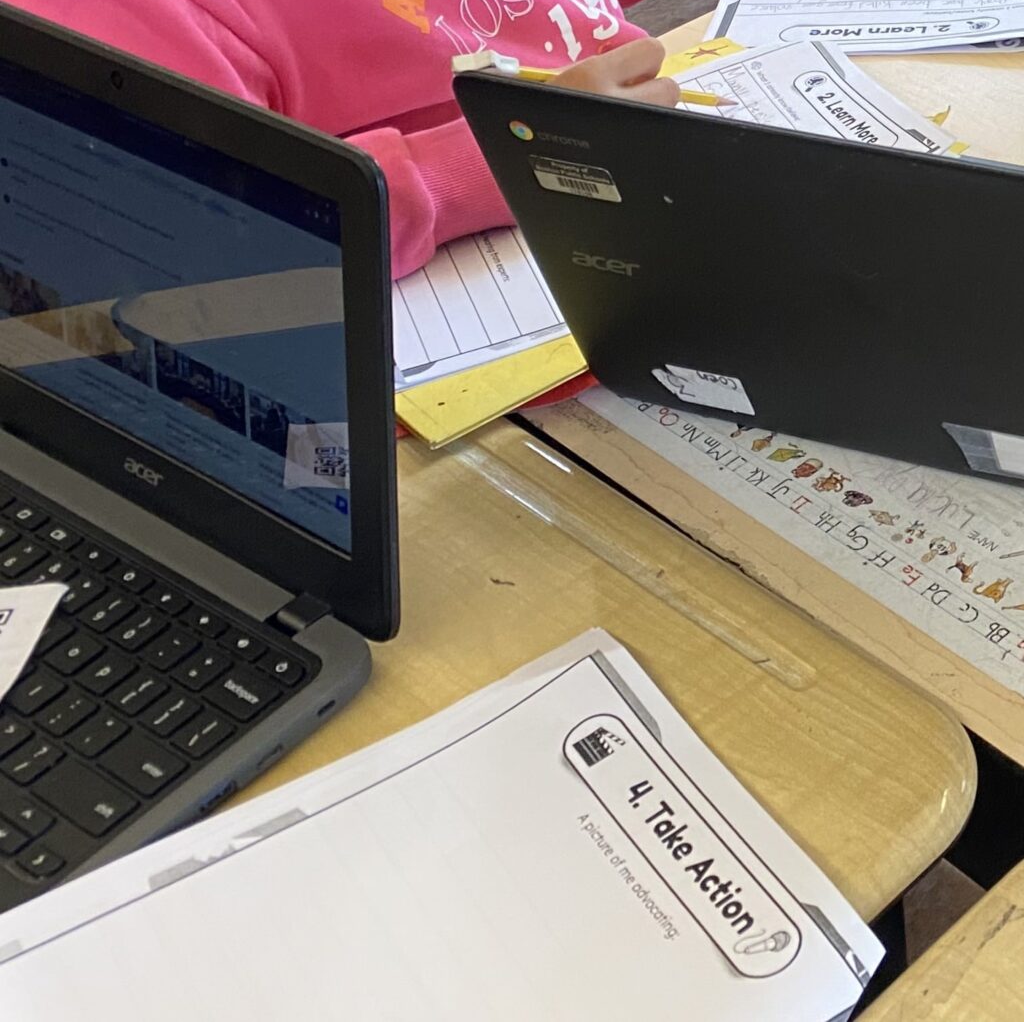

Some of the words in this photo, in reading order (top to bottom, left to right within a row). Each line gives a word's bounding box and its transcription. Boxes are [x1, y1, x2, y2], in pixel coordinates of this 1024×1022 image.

[808, 28, 863, 38] More
[868, 26, 927, 34] Learn
[817, 91, 835, 105] 2.
[825, 100, 856, 128] Learn
[849, 120, 880, 145] More
[572, 250, 640, 277] acer
[659, 407, 680, 426] Oo
[680, 423, 705, 442] Nn
[704, 436, 729, 461] Mm
[123, 455, 164, 488] acer
[746, 467, 770, 486] Kk
[766, 478, 792, 499] Jj
[814, 511, 841, 533] Hh
[846, 525, 869, 551] Gg
[967, 530, 999, 552] NAME
[867, 550, 896, 568] Ff
[902, 565, 923, 586] Ee
[921, 583, 951, 605] Dd
[958, 603, 978, 623] Cc
[985, 623, 1010, 644] Bb
[577, 813, 589, 825] A
[581, 821, 614, 858] picture
[610, 855, 625, 869] of
[627, 779, 654, 809] 4.
[644, 800, 694, 862] Take
[684, 857, 755, 935] Action
[619, 868, 636, 886] me
